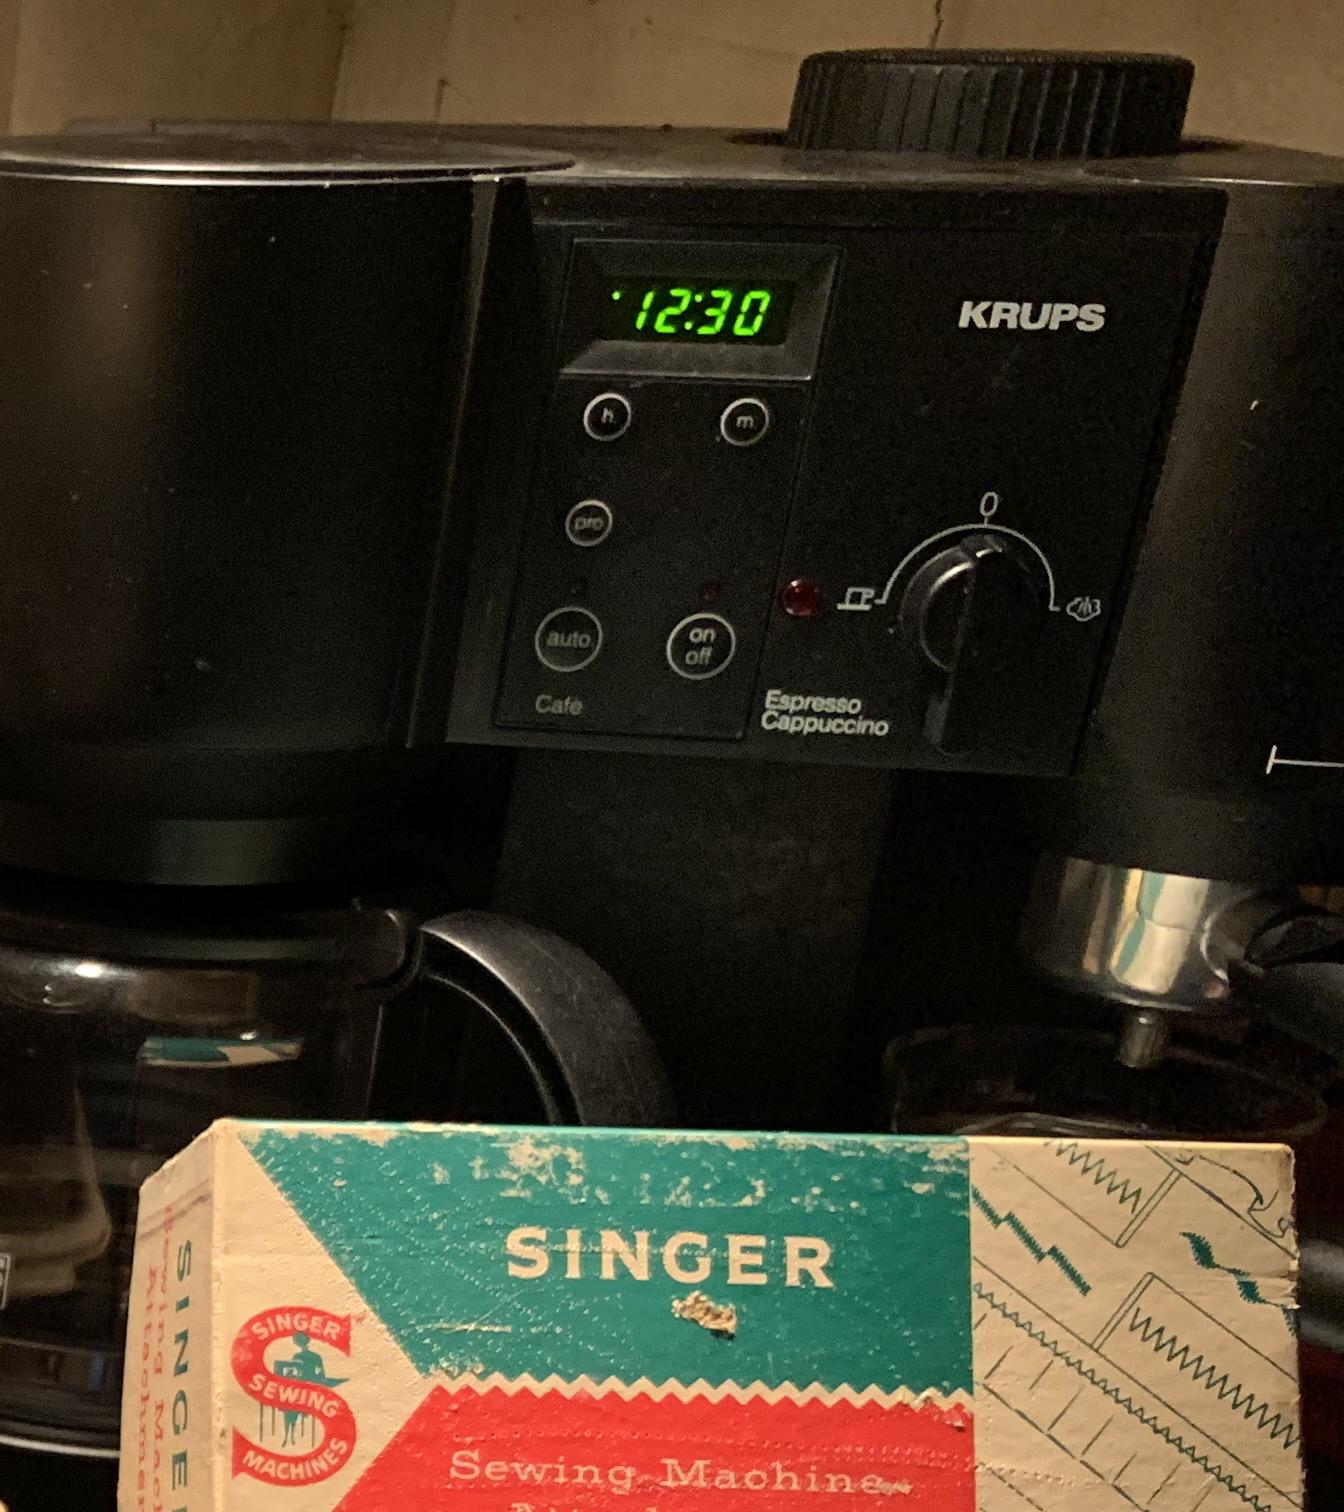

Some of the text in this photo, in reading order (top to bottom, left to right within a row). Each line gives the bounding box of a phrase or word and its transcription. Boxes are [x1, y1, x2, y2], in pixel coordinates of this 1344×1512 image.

[634, 288, 771, 337] 12:30
[957, 299, 1107, 333] KRUPS
[545, 630, 591, 649] auto
[688, 626, 717, 642] on
[684, 647, 715, 666] off
[764, 688, 863, 715] Espresso
[761, 710, 890, 736] Cappuccino
[504, 1227, 836, 1290] SINGER
[251, 1313, 341, 1341] SINGER
[248, 1373, 340, 1418] SEWING
[242, 1437, 349, 1481] MACHINES
[448, 1447, 887, 1497] Sewing Machine
